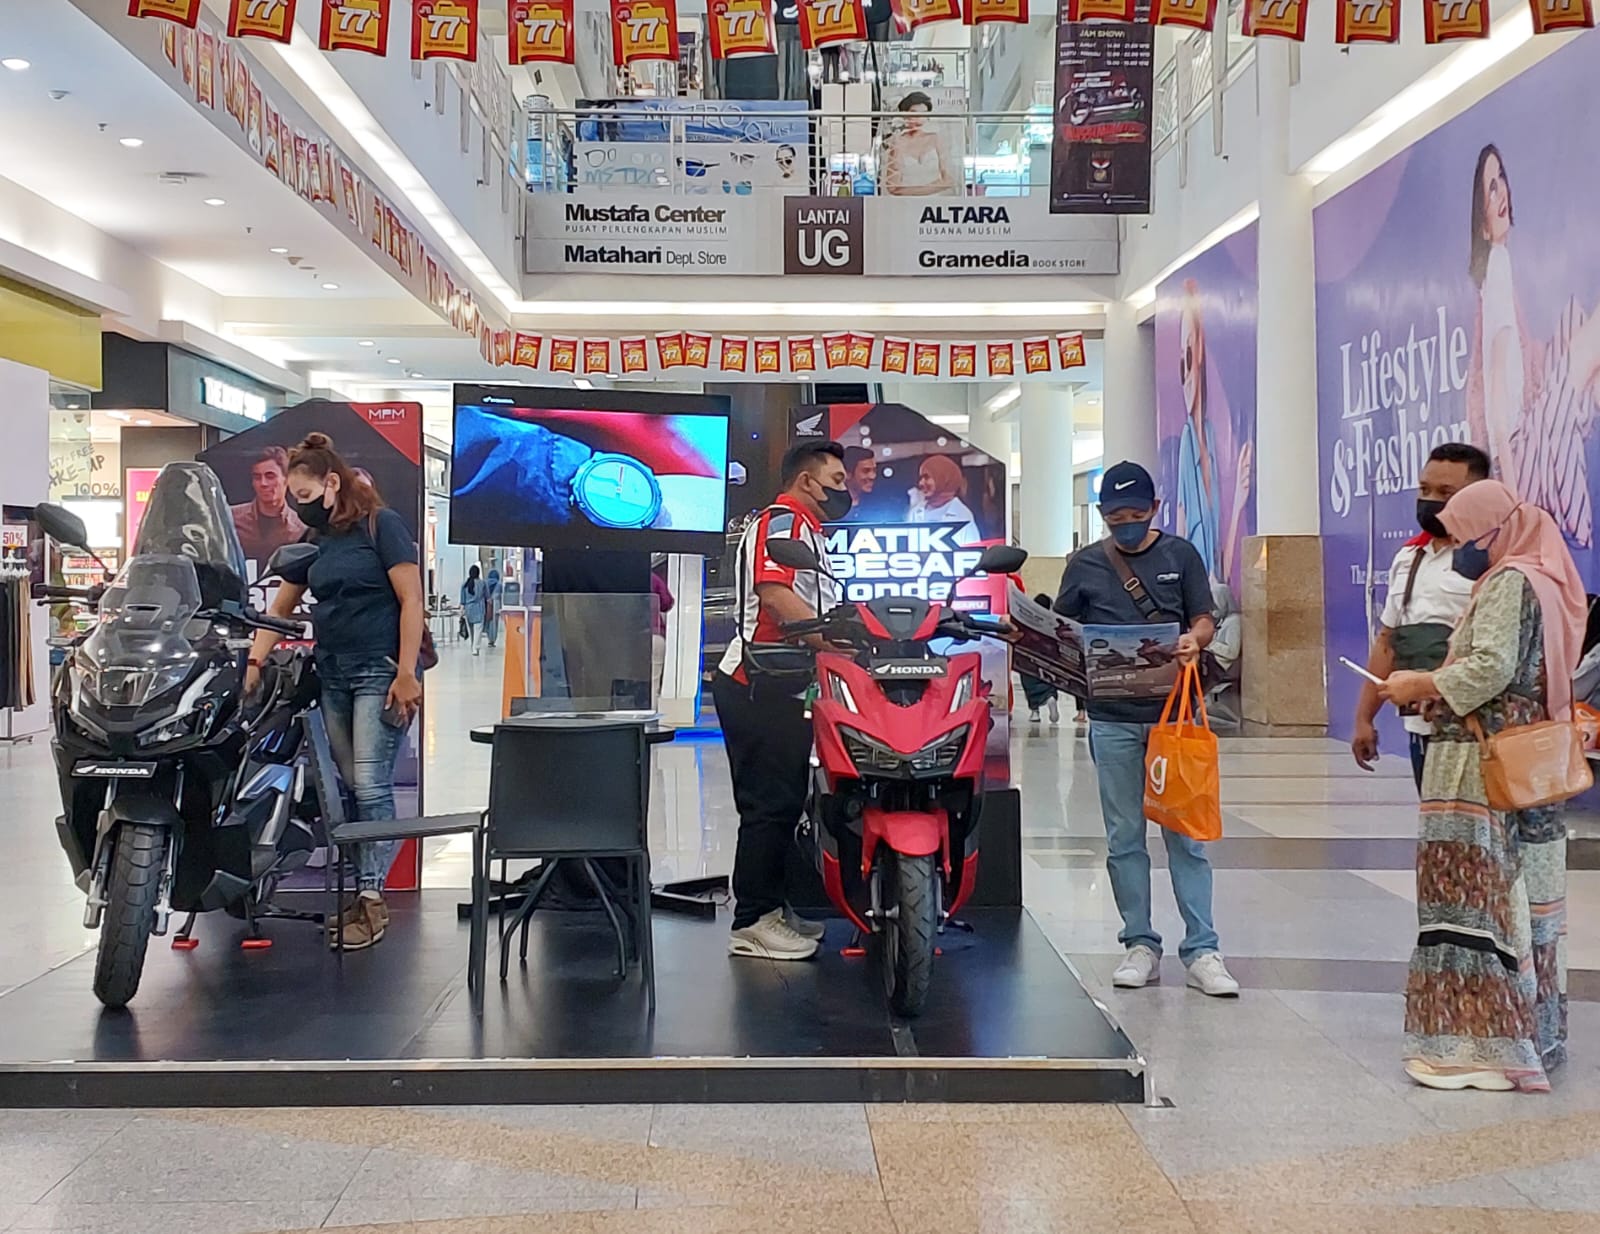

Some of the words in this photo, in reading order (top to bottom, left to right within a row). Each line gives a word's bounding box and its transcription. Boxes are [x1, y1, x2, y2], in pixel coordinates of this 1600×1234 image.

[565, 203, 650, 222] Mustafa
[654, 204, 726, 223] Center
[797, 209, 849, 225] LANTAI
[919, 206, 1010, 224] ALTARA
[565, 225, 597, 233] PUSAT
[602, 225, 682, 234] PERLENGKAPAN
[687, 226, 727, 234] MUSLIM
[919, 227, 962, 235] BUSANA
[968, 227, 1012, 235] MUSLIM
[565, 245, 662, 264] Matahari
[666, 250, 695, 267] Dept.
[697, 251, 727, 265] Store
[798, 228, 850, 268] UG
[918, 250, 1030, 268] Gramedia
[1032, 260, 1057, 268] BOOK
[1059, 260, 1086, 268] STORE
[1340, 305, 1468, 422] Lifestyle
[73, 482, 119, 497] 100%
[3, 531, 24, 545] 50%
[890, 666, 945, 674] HONDA
[94, 767, 149, 775] HONDA
